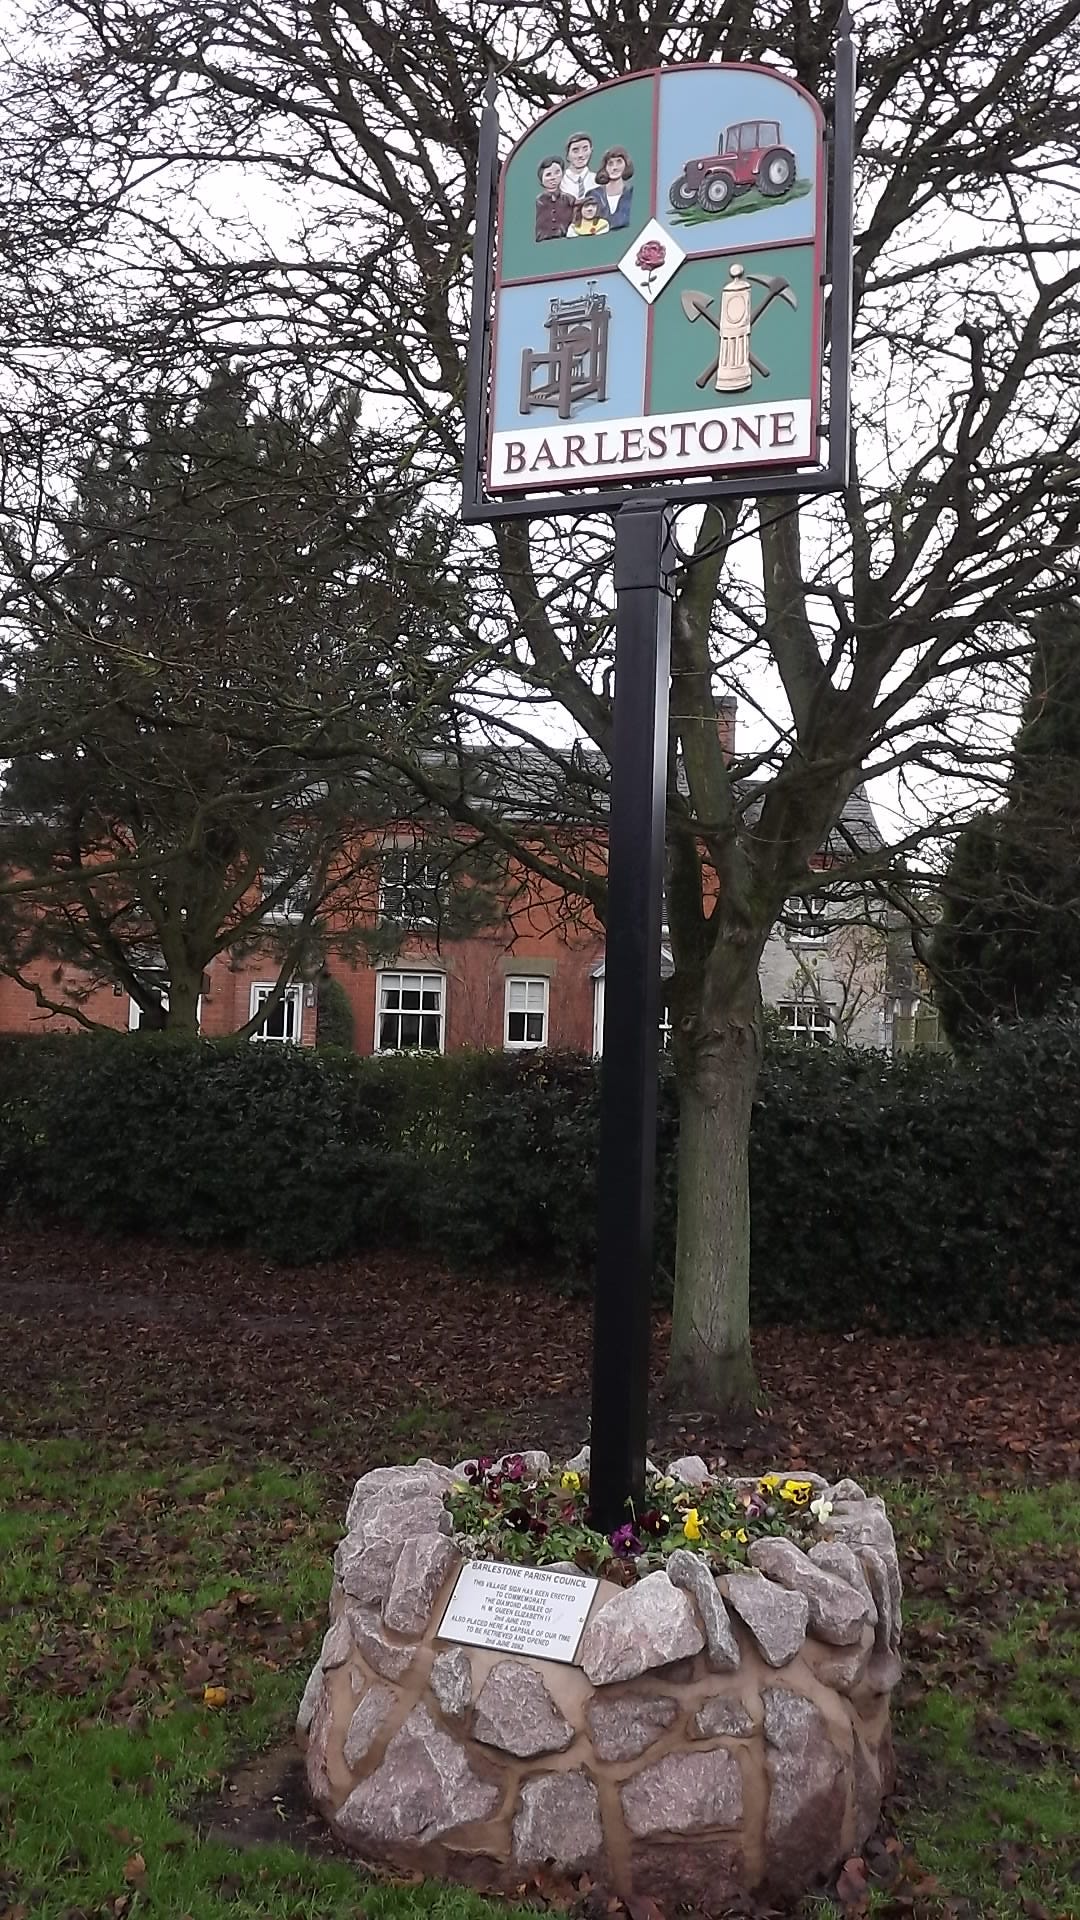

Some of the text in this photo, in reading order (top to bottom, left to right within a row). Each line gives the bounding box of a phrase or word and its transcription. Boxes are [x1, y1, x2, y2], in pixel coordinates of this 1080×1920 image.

[503, 412, 798, 475] BARLESTONE
[472, 1562, 587, 1588] BARLESTONE PARISH COUNCIL
[486, 1582, 507, 1590] VILLAGE
[551, 1592, 575, 1601] ERECTED
[505, 1592, 546, 1605] COMMEMORATE
[495, 1607, 514, 1616] QUEEN
[515, 1610, 544, 1621] ELIZABETH
[496, 1599, 521, 1608] DIAMOND
[522, 1604, 542, 1612] JUBILEE
[467, 1618, 488, 1628] PLACED
[489, 1622, 504, 1631] HERE
[510, 1626, 534, 1636] CAPSULE
[484, 1629, 513, 1640] RETRIEVED
[527, 1638, 549, 1646] OPENED
